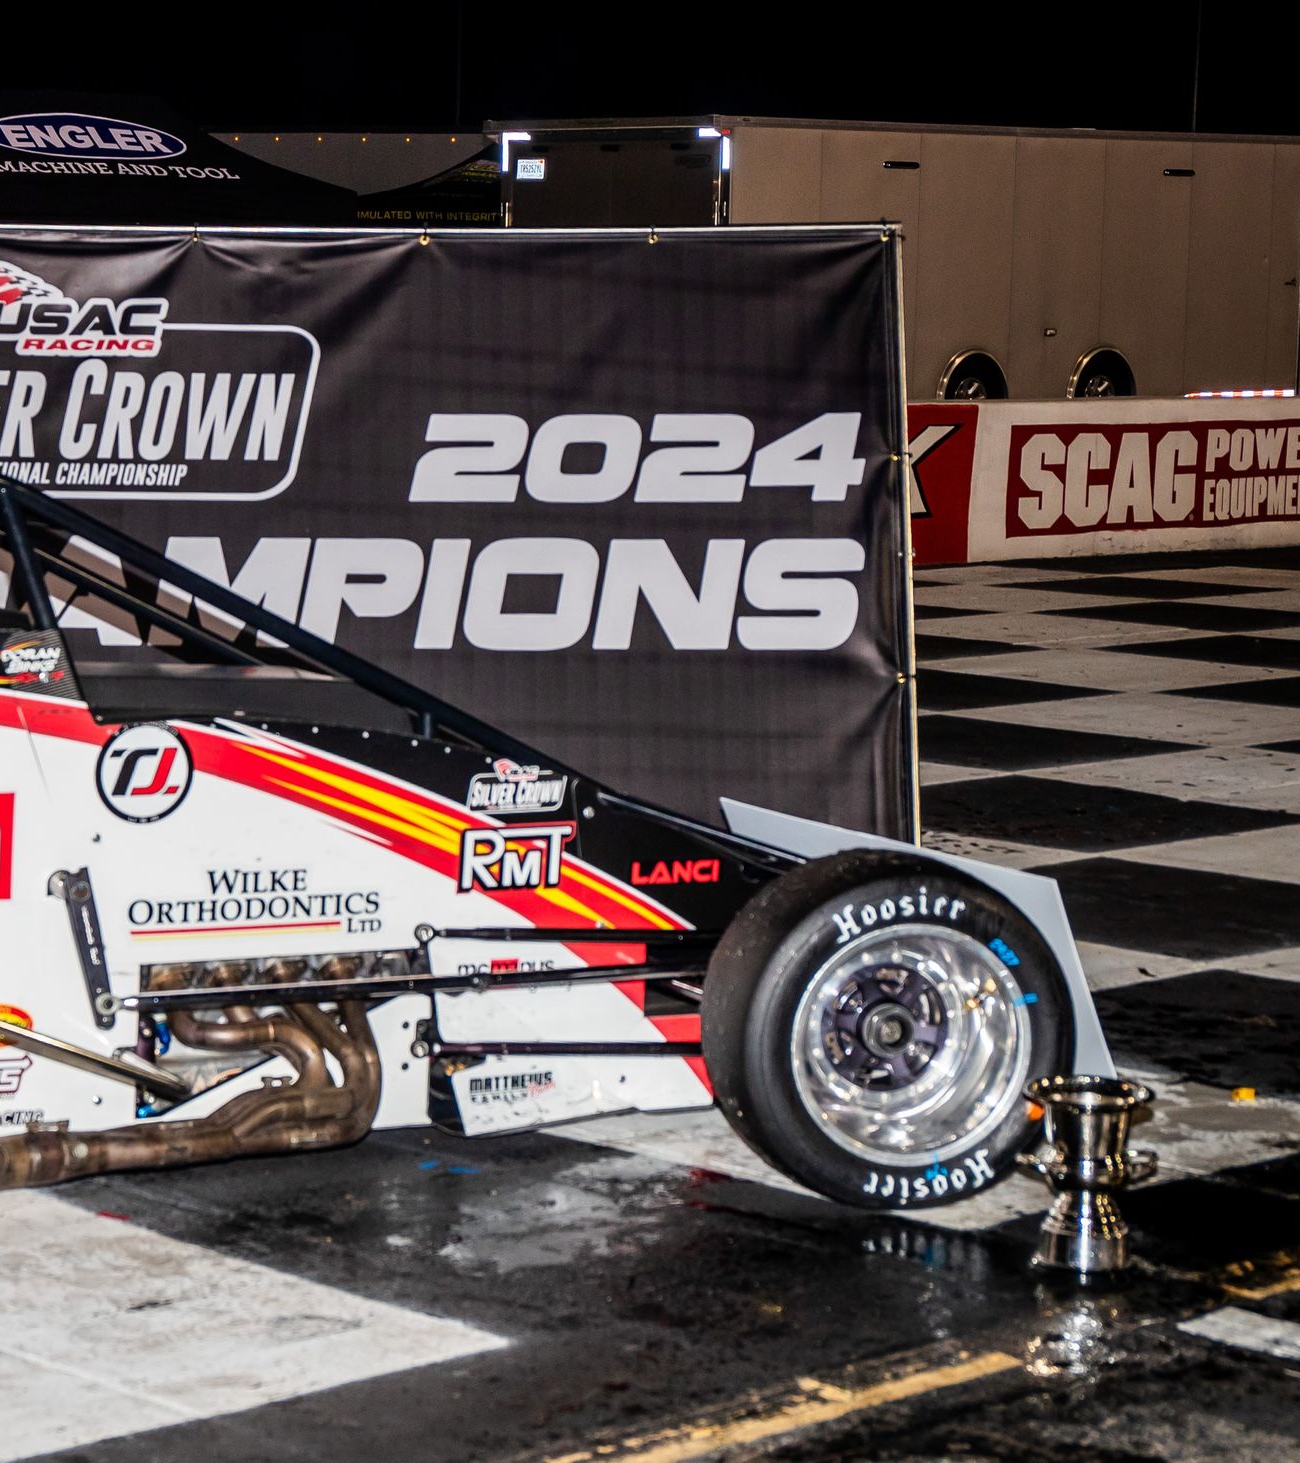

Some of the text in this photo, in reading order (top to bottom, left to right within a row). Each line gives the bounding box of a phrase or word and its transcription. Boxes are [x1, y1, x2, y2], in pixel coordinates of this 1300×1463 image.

[118, 162, 168, 178] AND
[168, 166, 240, 182] TOOL
[415, 210, 444, 221] WITH
[447, 211, 499, 222] INTEGRIT
[22, 338, 156, 352] RACING
[58, 358, 297, 461] CROWN
[55, 462, 189, 488] CHAMPIONSHIP
[408, 411, 867, 504] 2024
[1017, 429, 1199, 529] SCAG
[1202, 475, 1300, 521] EQUIPME
[471, 778, 565, 807] SILVER CROWN
[460, 825, 574, 891] RMT
[631, 859, 721, 886] LANCI
[206, 868, 308, 895] WILKE
[127, 891, 381, 926] ORTHODONTICS
[831, 886, 967, 946] Hoosier
[863, 1149, 996, 1206] Hoosier
